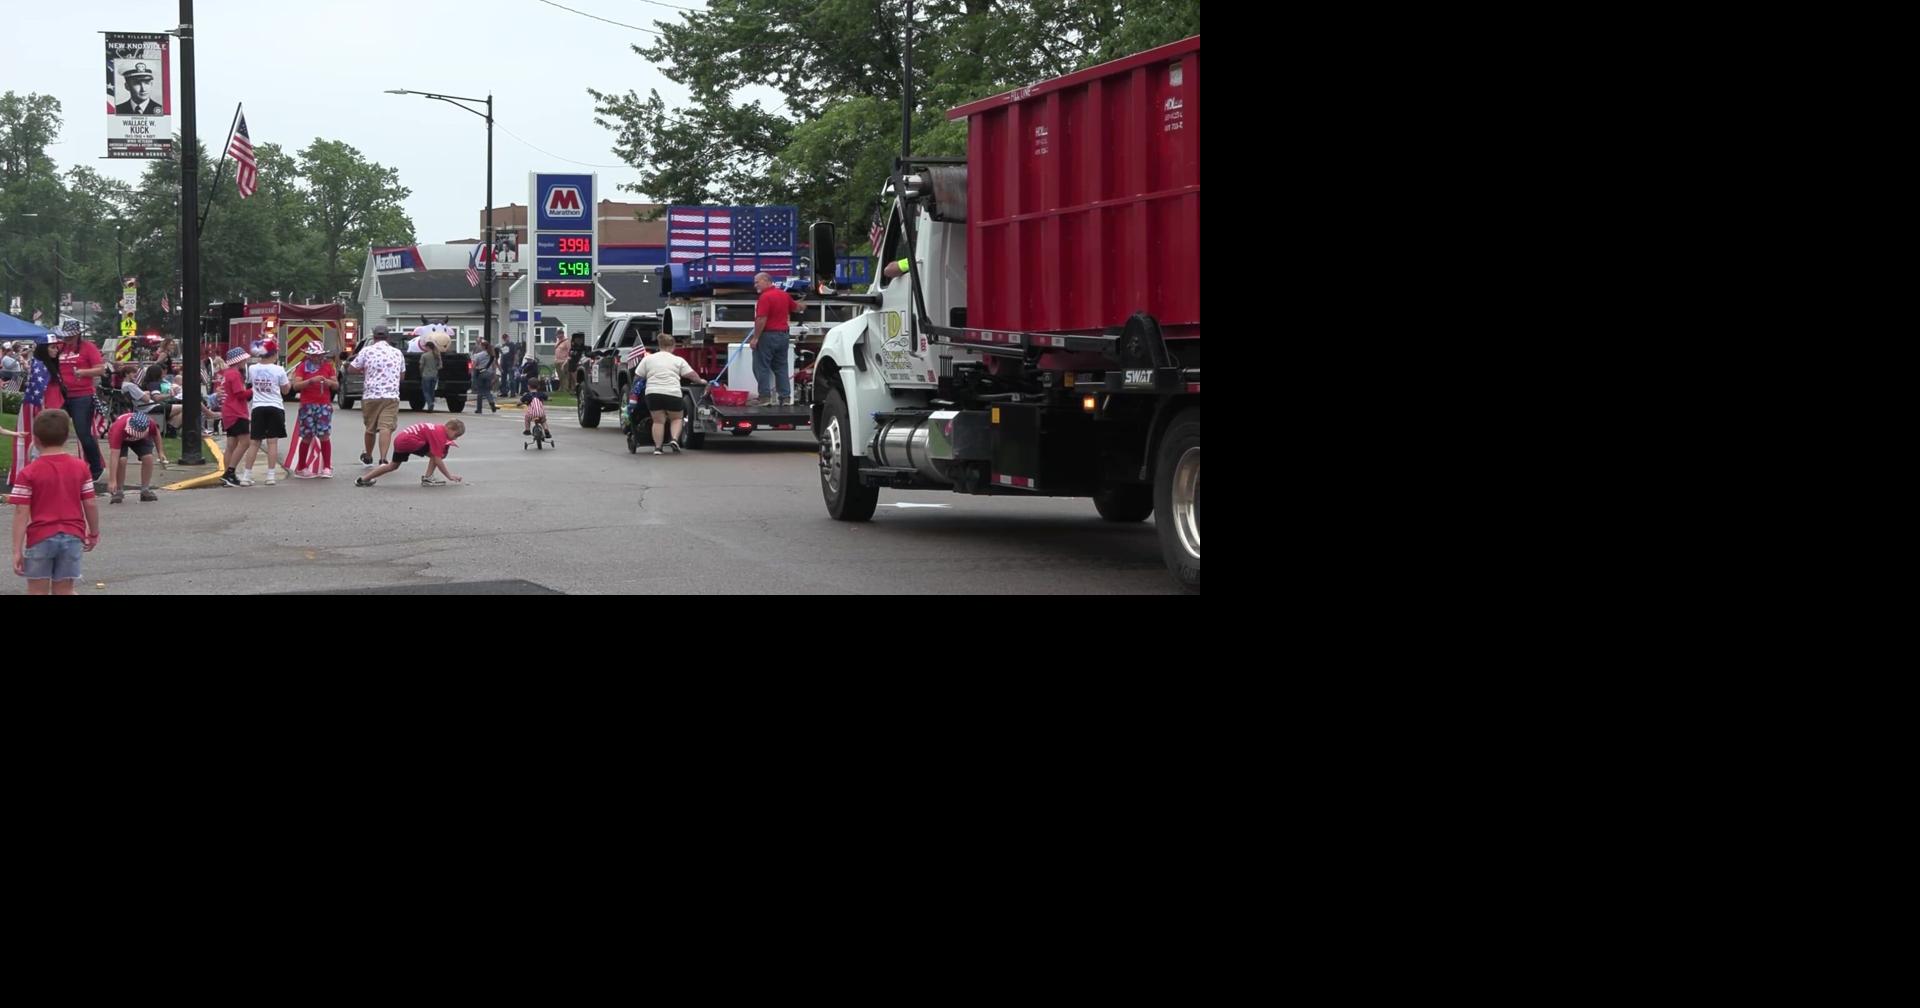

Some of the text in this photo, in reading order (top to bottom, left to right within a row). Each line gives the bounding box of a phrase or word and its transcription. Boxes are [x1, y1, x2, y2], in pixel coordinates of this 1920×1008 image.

[127, 42, 167, 50] KNOXVILLE
[130, 126, 150, 134] KUCK
[376, 252, 402, 270] Marathon
[547, 289, 585, 297] PIZZA
[1124, 370, 1153, 383] SWAT
